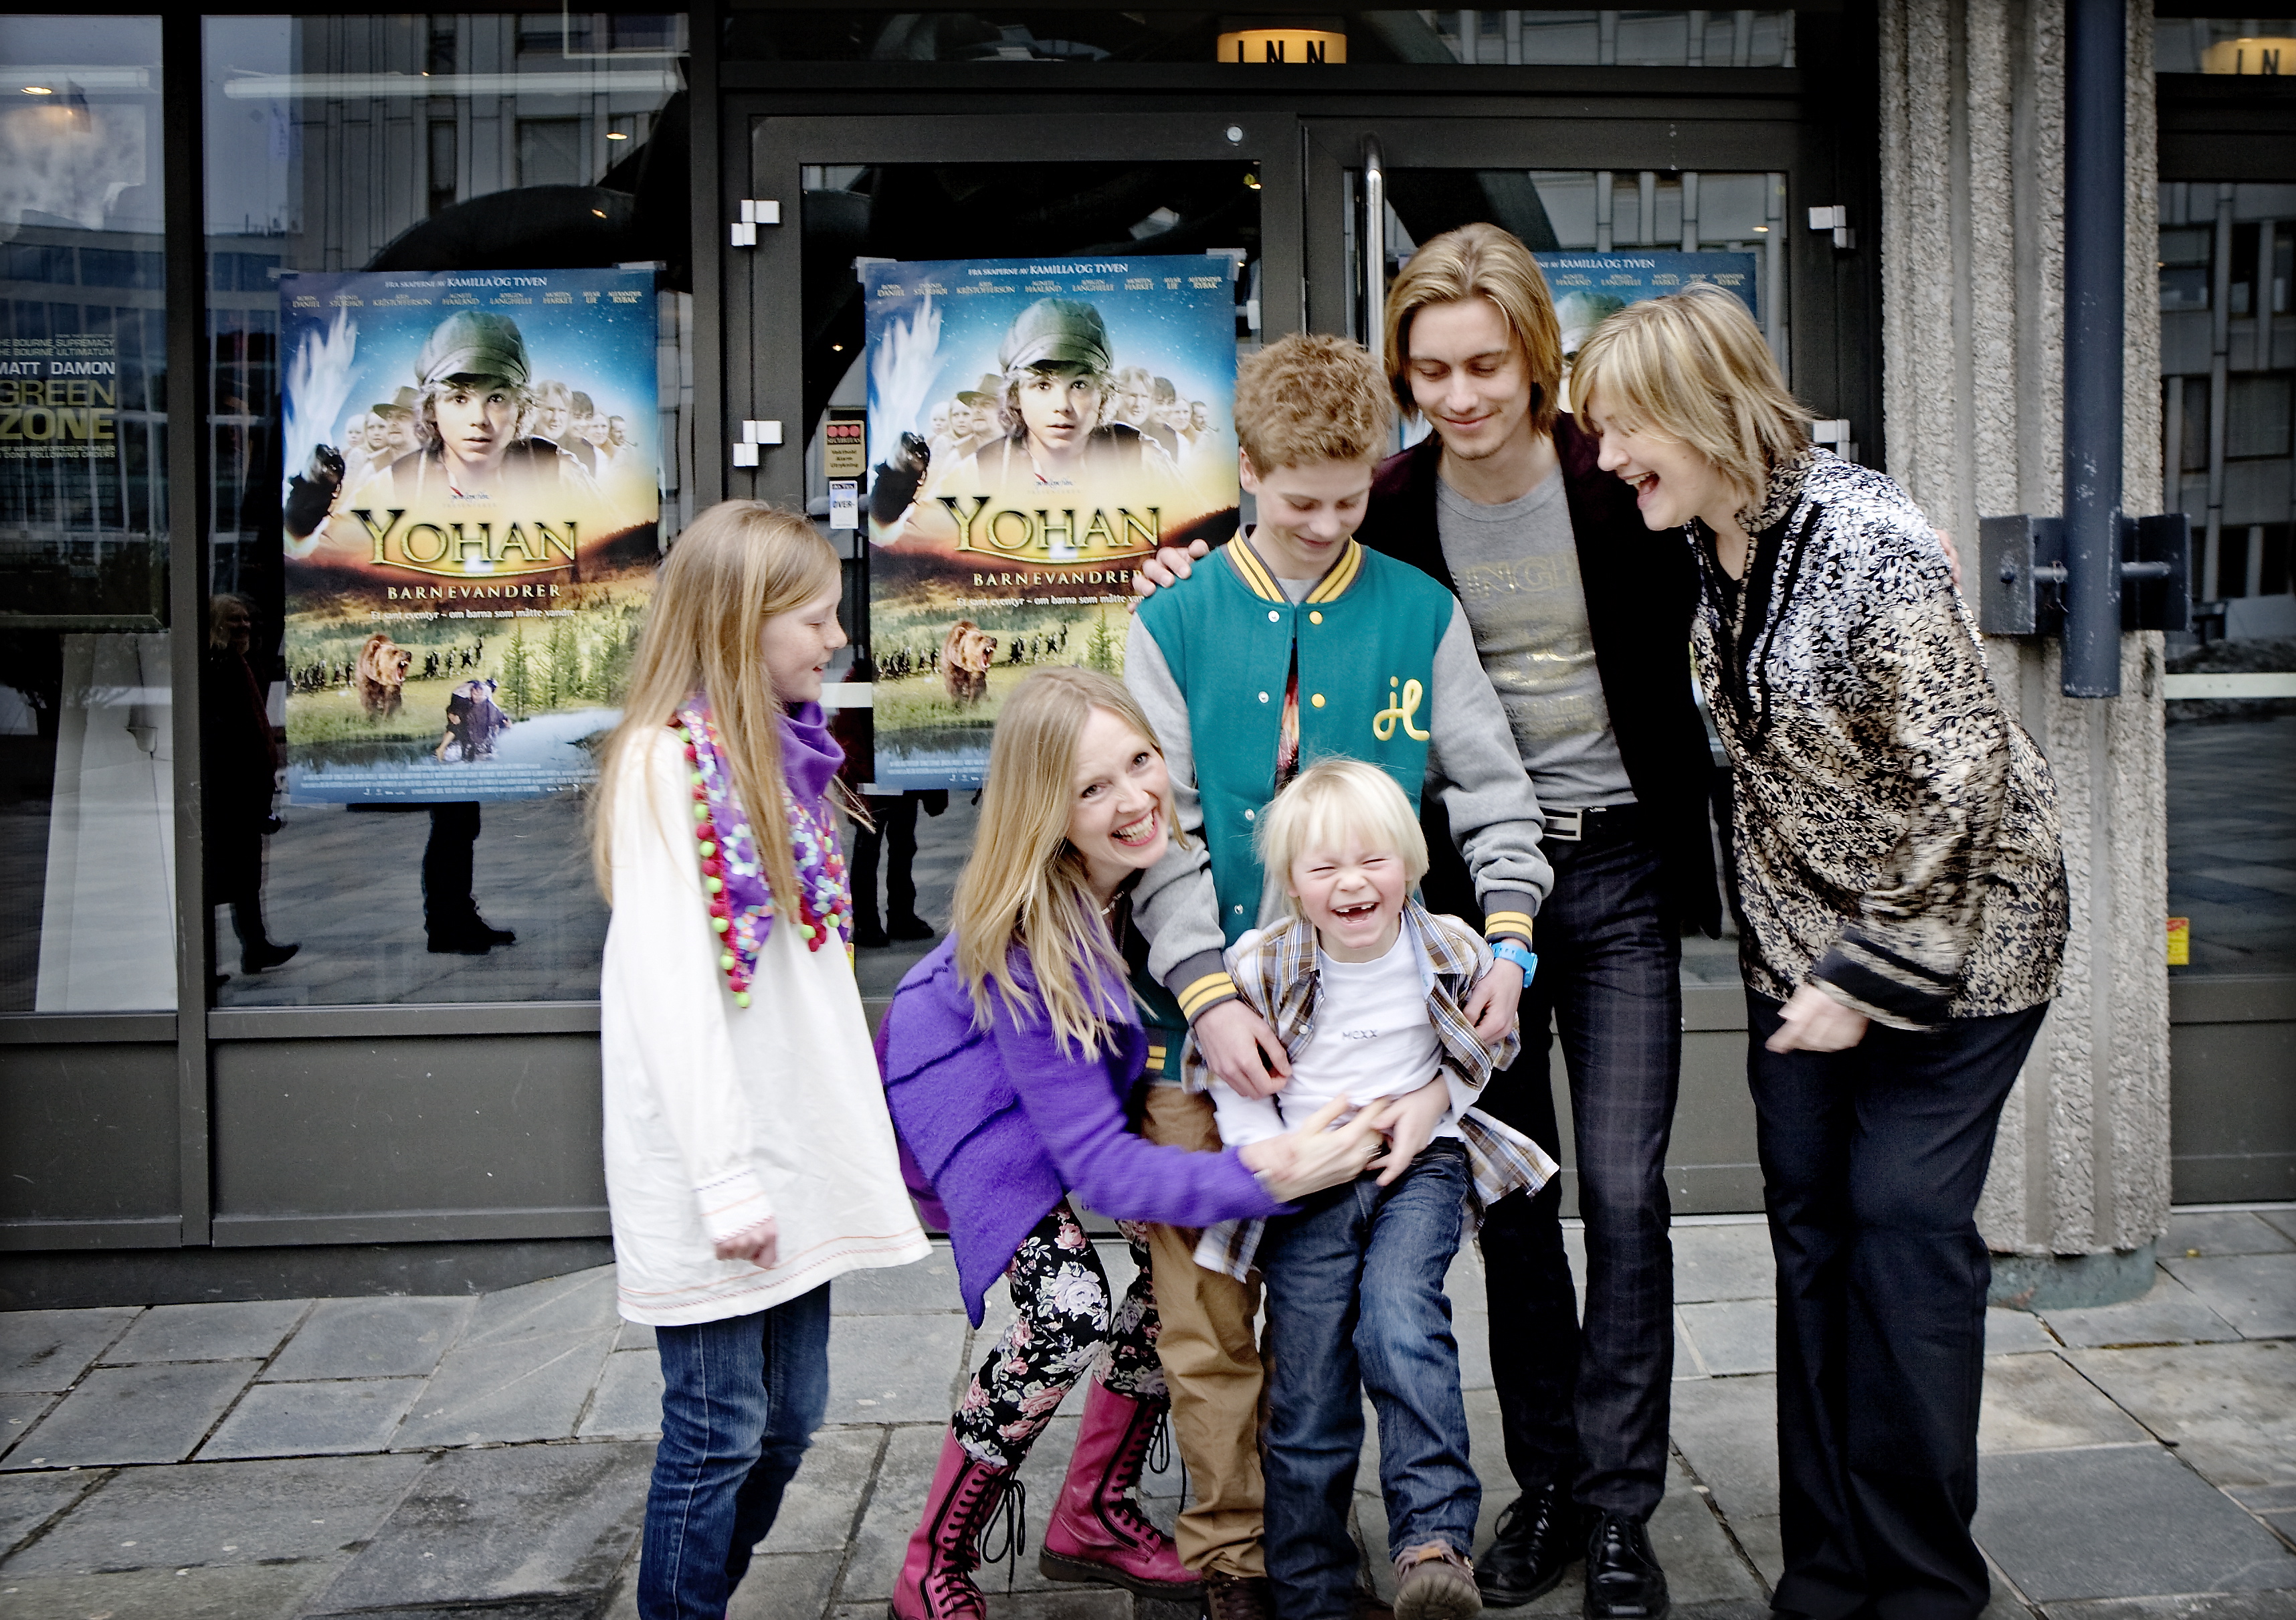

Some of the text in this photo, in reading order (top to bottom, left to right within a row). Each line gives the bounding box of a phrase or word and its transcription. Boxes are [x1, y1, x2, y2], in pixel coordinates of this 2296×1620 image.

[1238, 40, 1325, 63] INN
[2237, 49, 2279, 74] IN
[1030, 264, 1075, 274] KAMILLA
[1076, 263, 1092, 274] OG
[1094, 263, 1129, 273] TYVEN
[1559, 259, 1604, 268] KAMILLA
[1604, 258, 1622, 268] OG
[1623, 258, 1655, 268] TYVEN
[447, 278, 492, 287] KAMILLA
[493, 276, 511, 286] OG
[512, 276, 547, 286] TYVEN
[0, 339, 115, 347] HE BOURNE SUPREMACY
[0, 348, 115, 356] HE BOURNE ULTIMATUM
[50, 361, 116, 375] DAMON
[0, 379, 116, 406] GREEN
[0, 408, 116, 440] ZONE
[937, 497, 1160, 551] YOHAN
[351, 509, 577, 564] YOHAN
[387, 584, 561, 600] BARNEVANDRER
[989, 597, 1024, 608] eventyr
[1034, 597, 1050, 606] om
[1051, 595, 1077, 605] barna
[1078, 596, 1098, 604] som
[1099, 594, 1126, 604] måtte
[405, 610, 440, 622] eventyr
[449, 611, 464, 619] om
[466, 608, 492, 618] barna
[494, 610, 514, 618] som
[516, 608, 543, 618] måtte
